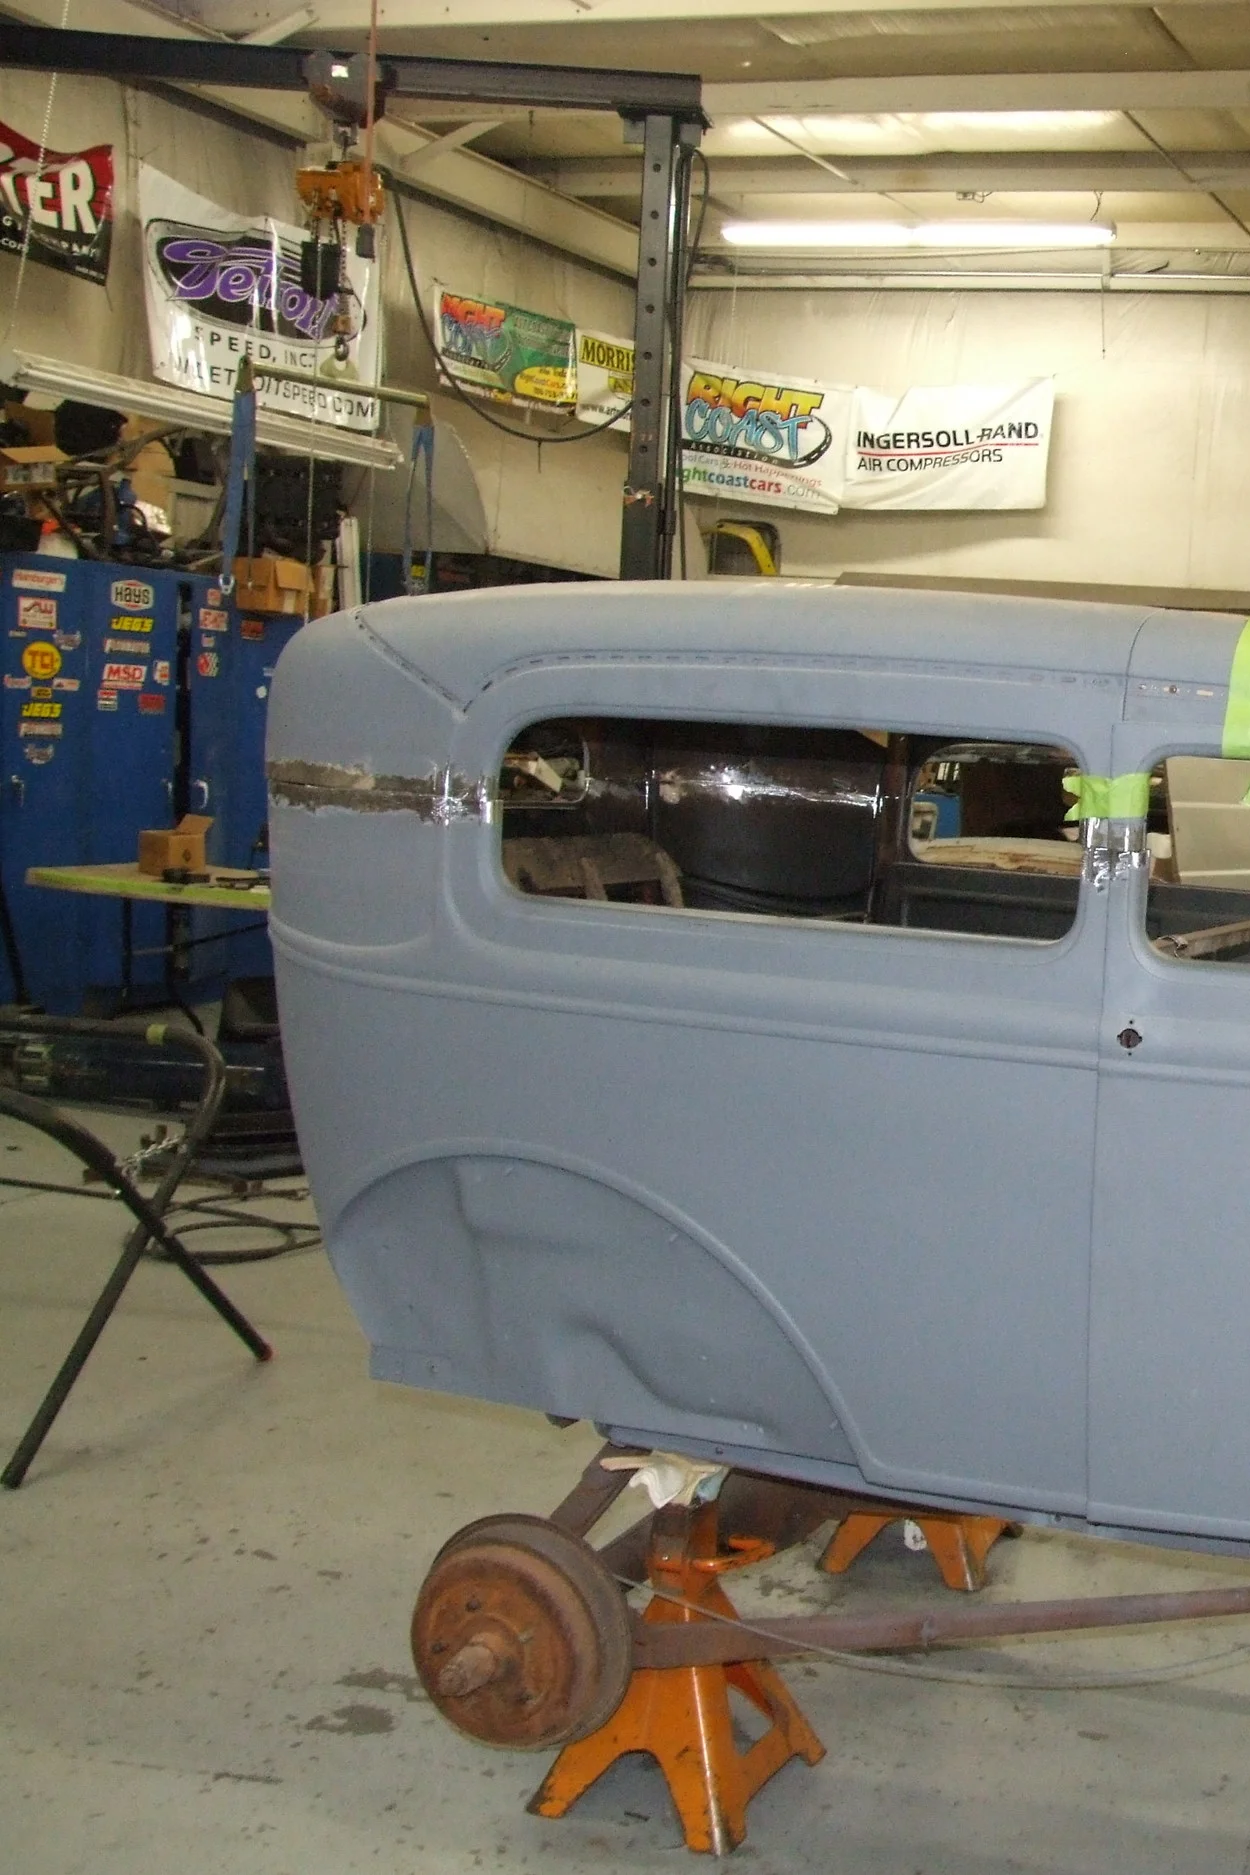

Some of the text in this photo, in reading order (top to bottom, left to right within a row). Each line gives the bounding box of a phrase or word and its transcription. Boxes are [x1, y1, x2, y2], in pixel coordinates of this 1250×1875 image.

[687, 371, 825, 429] RIGHT
[685, 399, 813, 463] COAST
[857, 422, 1039, 450] INGERSOLL-RAND
[690, 443, 779, 465] Association
[857, 449, 1003, 472] AIR COMPRESSORS
[681, 466, 822, 501] ghtcoastcars.com
[754, 465, 823, 488] Happenings
[108, 665, 143, 680] MSD
